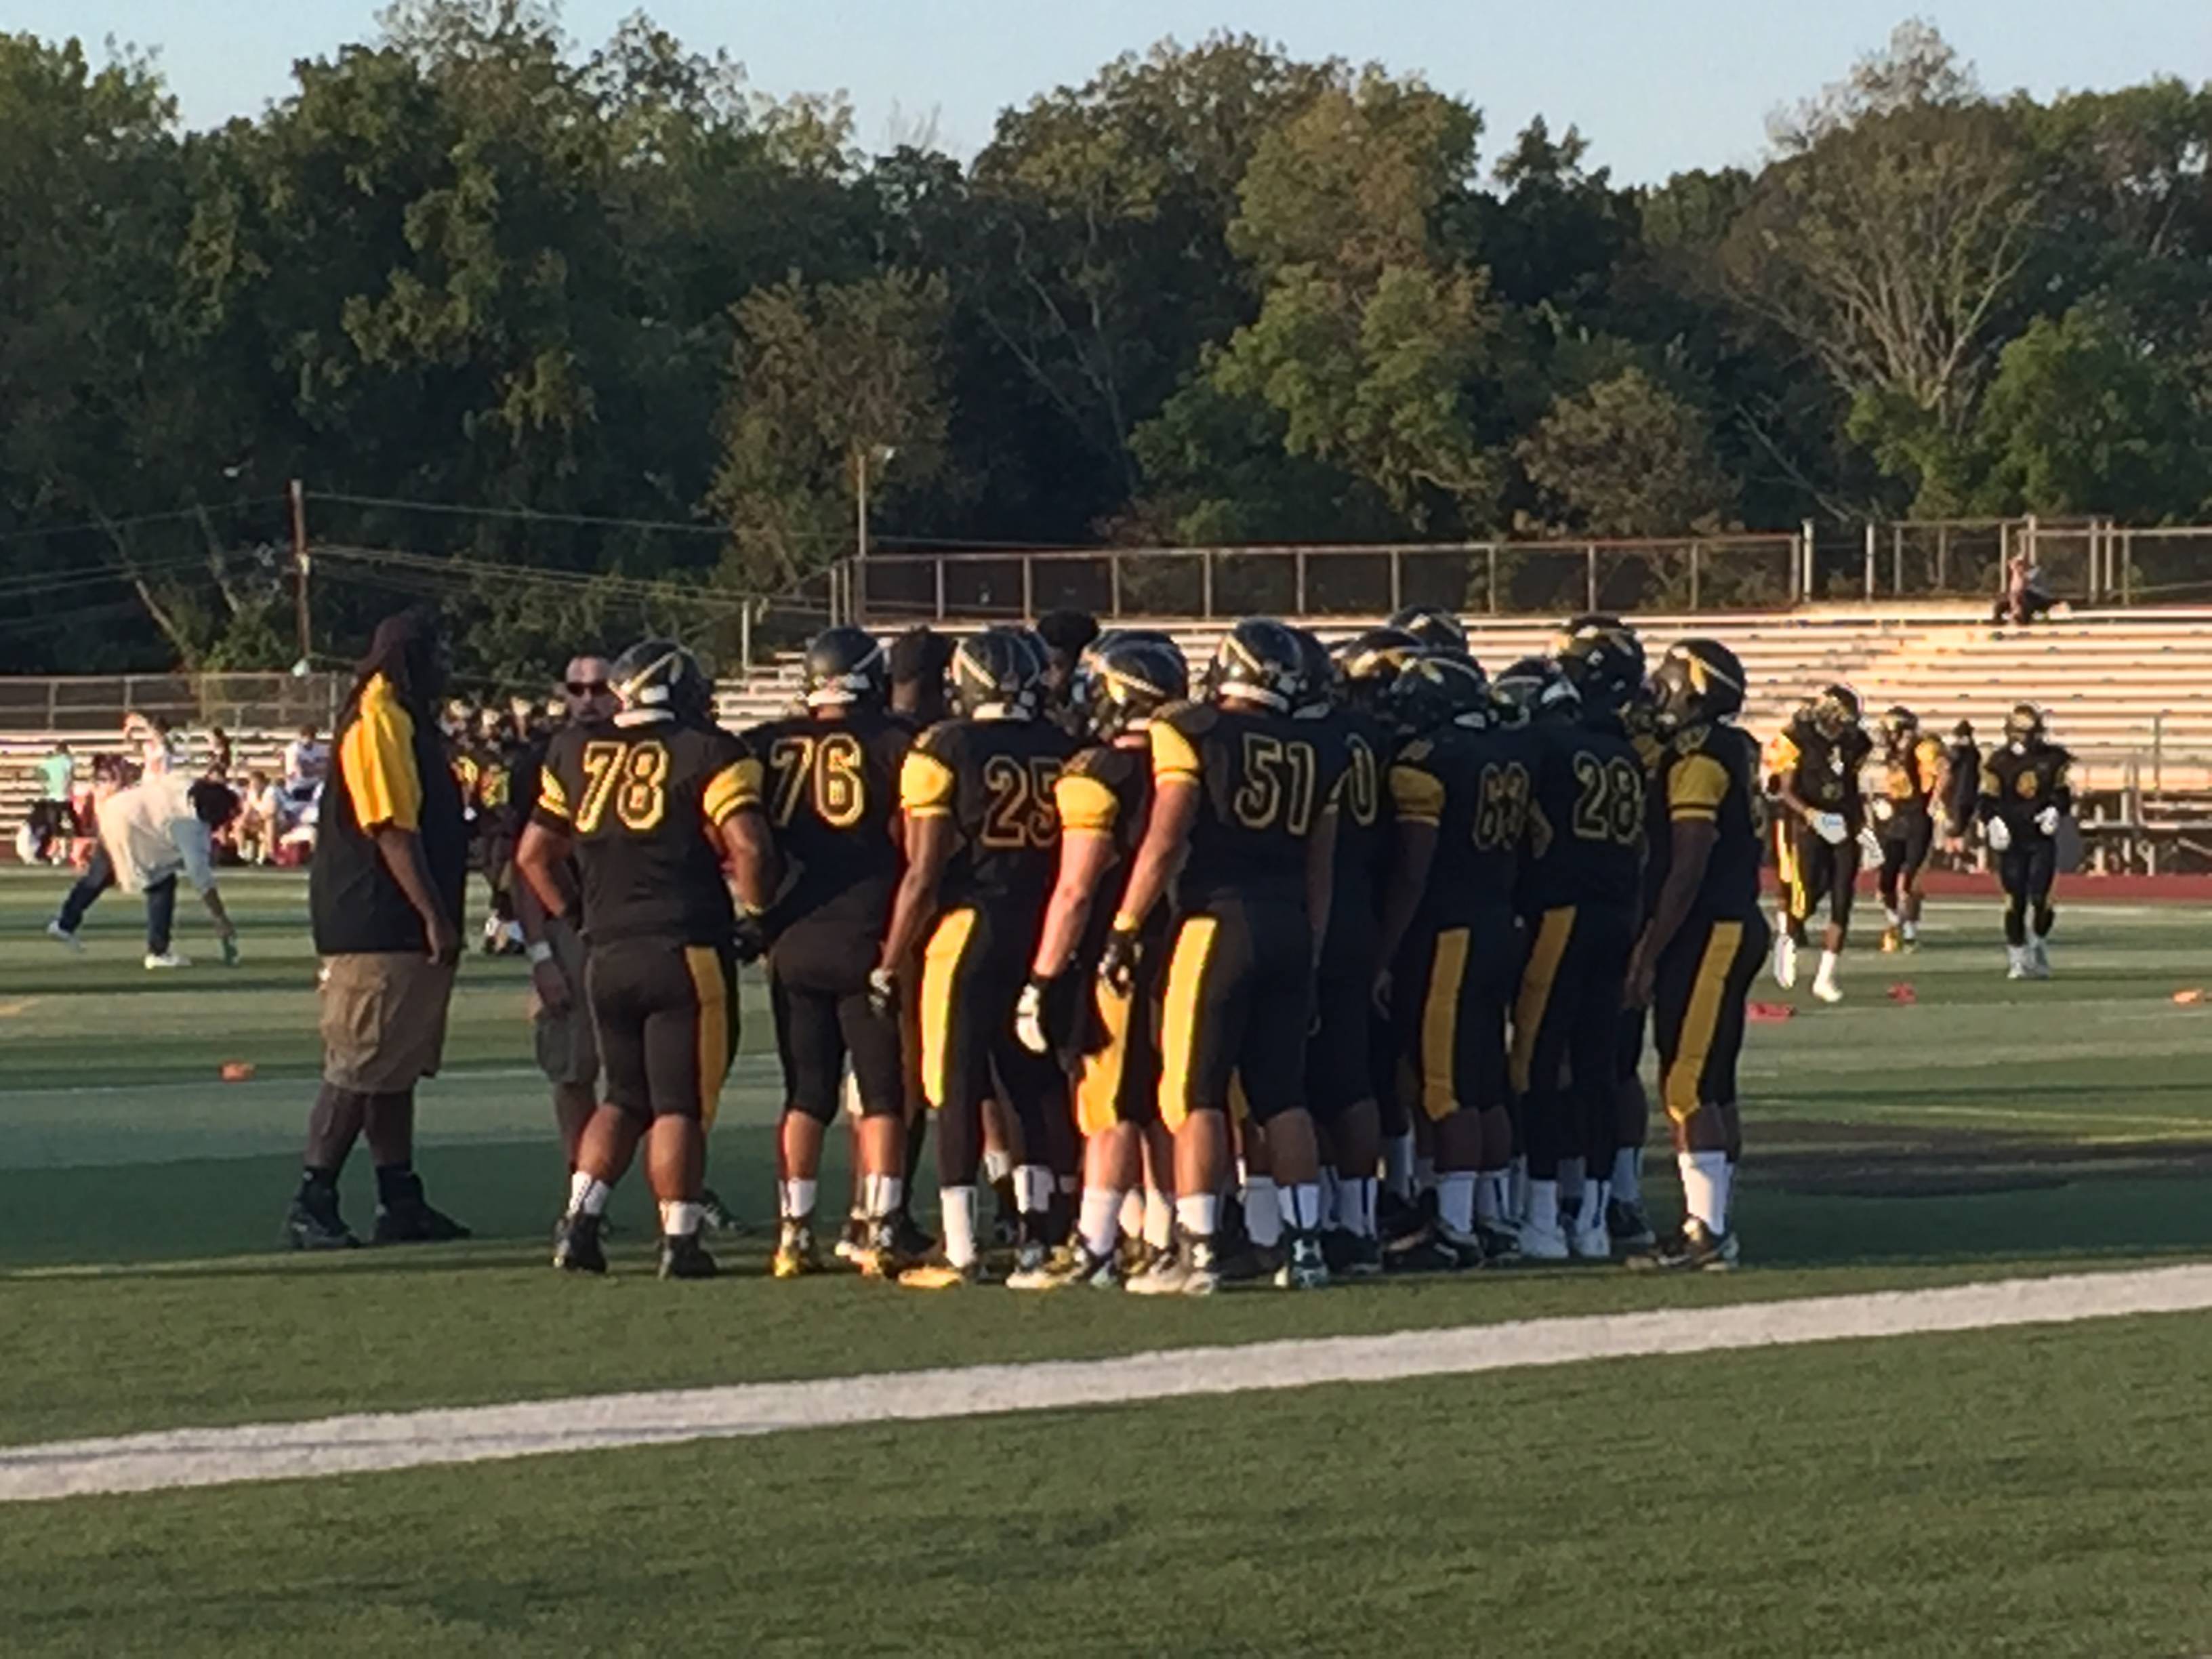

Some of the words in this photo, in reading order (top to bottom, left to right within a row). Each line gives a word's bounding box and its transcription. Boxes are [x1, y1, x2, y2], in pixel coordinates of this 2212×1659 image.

[576, 740, 670, 833] 78
[770, 733, 865, 828] 76
[981, 755, 1061, 847] 25
[1233, 732, 1315, 836] 51
[1573, 750, 1645, 845] 28
